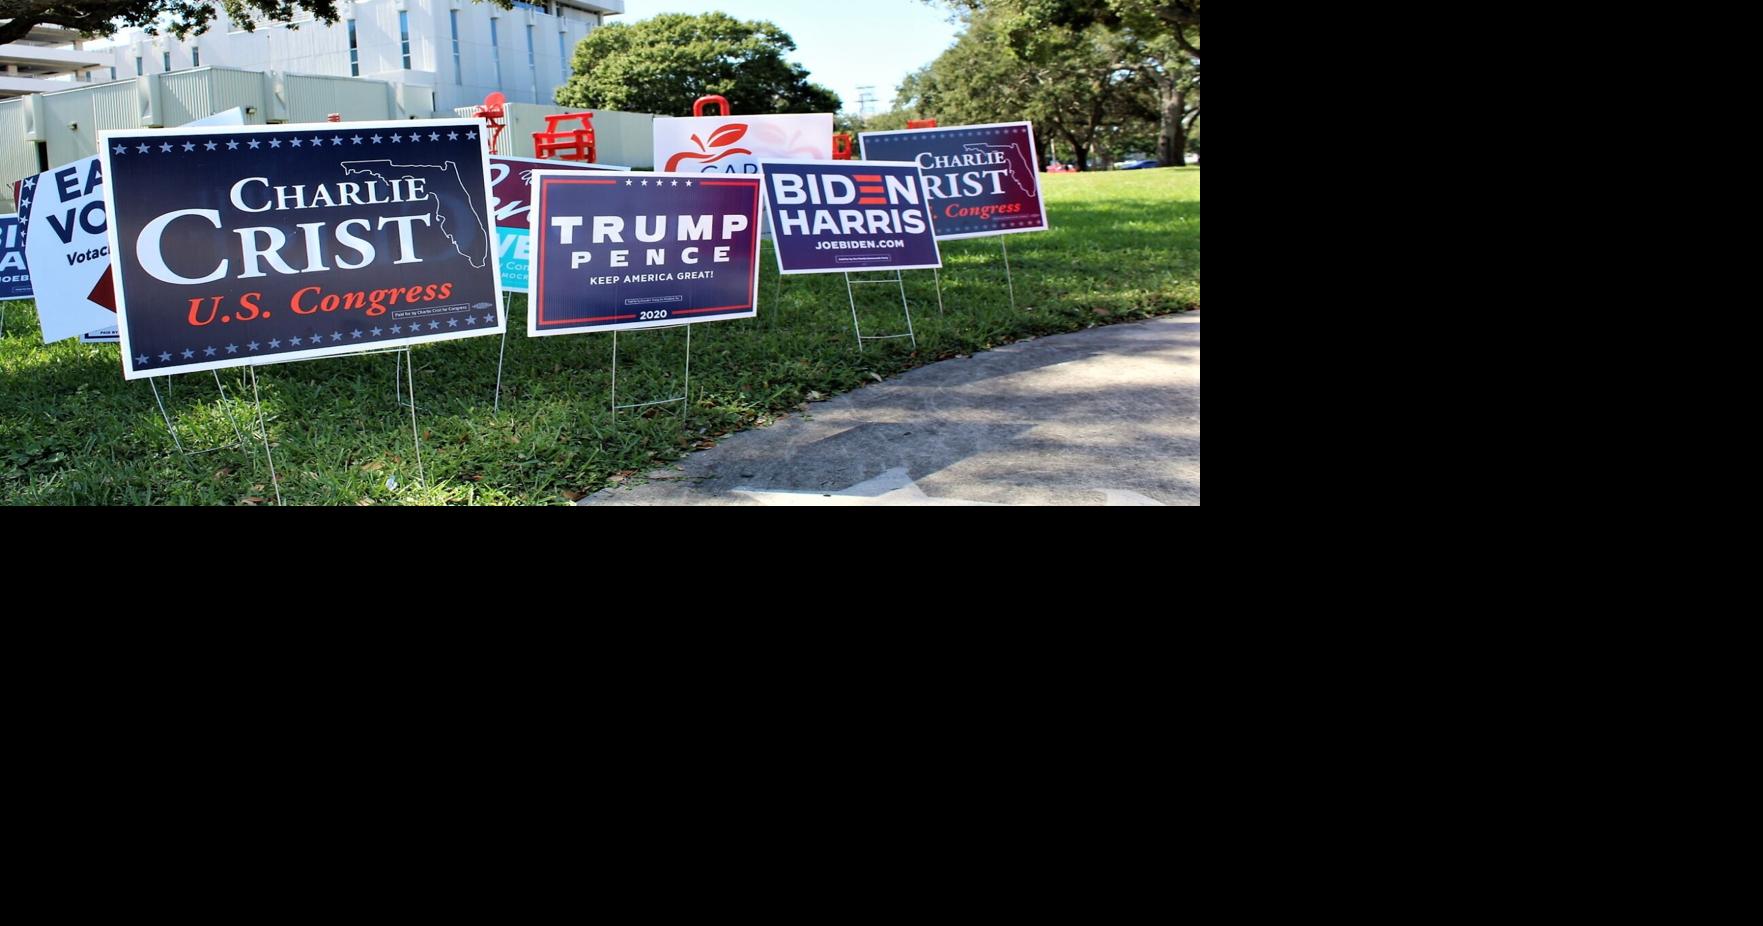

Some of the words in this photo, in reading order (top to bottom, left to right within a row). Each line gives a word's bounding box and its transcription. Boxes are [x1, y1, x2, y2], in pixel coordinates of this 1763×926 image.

[772, 173, 919, 205] BIDEN
[779, 209, 926, 235] HARRIS
[945, 203, 1021, 219] Congress
[551, 214, 748, 244] TRUMP
[815, 240, 905, 250] JOEBIDEN.COM
[571, 246, 731, 269] PENCE
[590, 275, 620, 285] KEEP
[623, 272, 674, 283] AMERICA
[676, 270, 714, 280] GREAT!
[188, 291, 272, 327] U.S.
[290, 282, 453, 317] Congress
[640, 310, 667, 320] 2020
